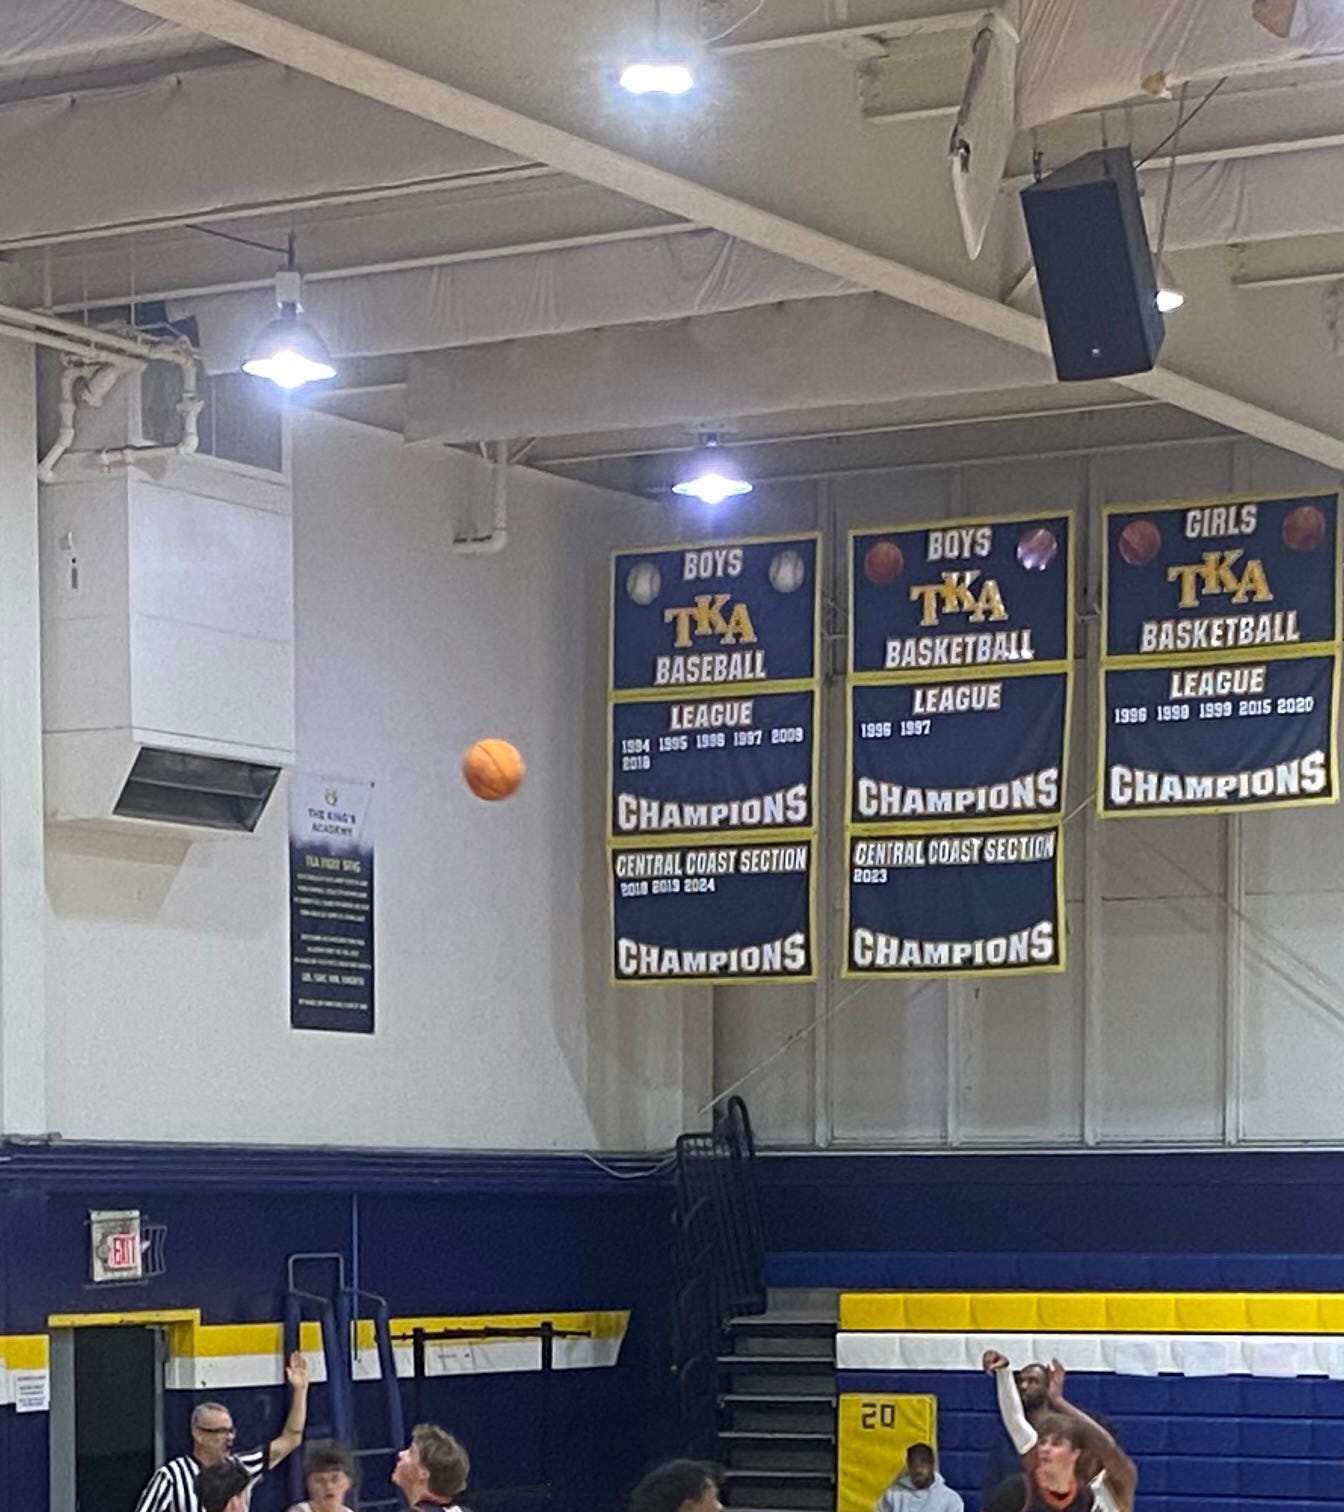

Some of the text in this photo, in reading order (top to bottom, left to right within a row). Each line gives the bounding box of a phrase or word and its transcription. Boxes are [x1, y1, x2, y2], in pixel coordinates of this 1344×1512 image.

[1185, 504, 1258, 539] GIRLS
[927, 527, 993, 562] BOYS
[683, 548, 744, 581] BOYS
[1167, 549, 1274, 608] TKA
[910, 569, 1008, 626] TKA
[664, 593, 758, 648] TKA
[1140, 610, 1301, 653] BASKETBALL
[884, 630, 1035, 669] BASKETBALL
[655, 650, 767, 685] BASEBALL
[1169, 665, 1267, 700] LEAGUE
[670, 701, 754, 731] LEAGUE
[912, 682, 1003, 715] LEAGUE
[1199, 702, 1232, 719] 1999
[1238, 699, 1272, 716] 2015
[1277, 696, 1314, 714] 2020
[659, 735, 688, 751] 1995
[733, 730, 762, 746] 1997
[860, 719, 931, 738] 1996 1997
[858, 767, 1059, 817] CHAMPIONS
[1110, 750, 1326, 805] CHAMPIONS
[618, 783, 807, 832] CHAMPIONS
[616, 846, 808, 878] CENTRAL COAST SECTION
[854, 832, 1056, 867] CENTRAL COAST SECTION
[684, 877, 716, 892] 2024
[853, 868, 888, 883] 2023
[618, 930, 806, 975] CHAMPIONS
[853, 919, 1054, 968] CHAMPIONS
[862, 1403, 895, 1429] 20
